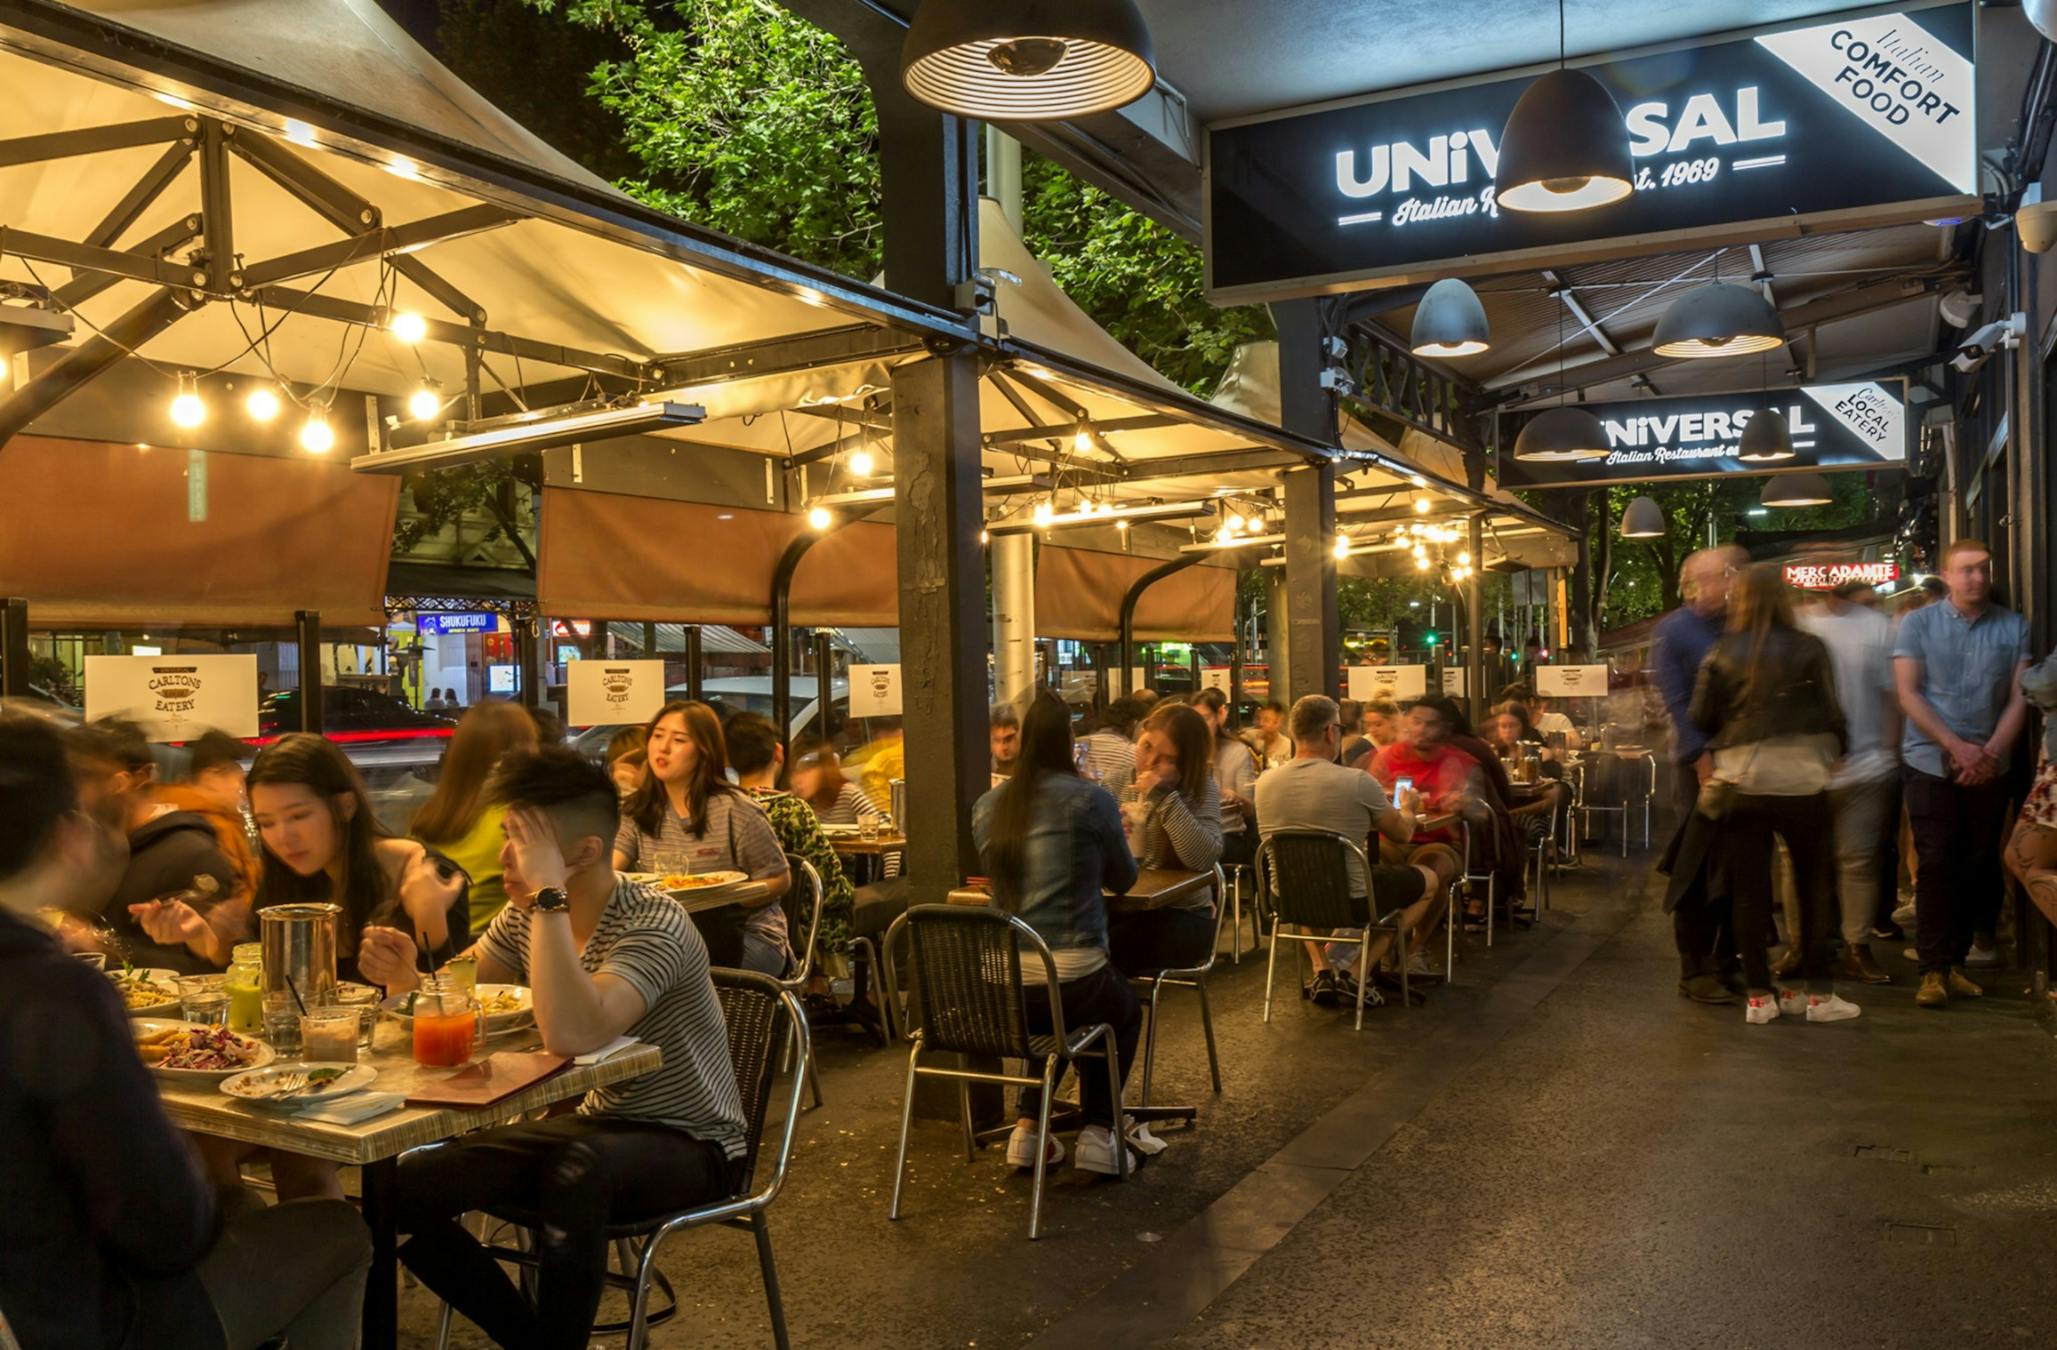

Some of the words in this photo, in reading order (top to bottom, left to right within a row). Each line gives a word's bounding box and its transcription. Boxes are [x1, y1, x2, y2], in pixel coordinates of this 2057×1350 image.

[1831, 30, 1960, 124] COMFORT
[1876, 29, 1945, 83] Italian
[1834, 65, 1909, 125] FOOD
[1336, 86, 1786, 198] UNiVSAL
[1392, 196, 1478, 226] Italian
[1661, 157, 1720, 187] 1969
[1600, 405, 1815, 447] NiVERSL
[1834, 400, 1886, 442] EATERY
[1847, 394, 1889, 432] LOCAL
[1606, 451, 1653, 465] Italian
[155, 699, 195, 712] EATERY
